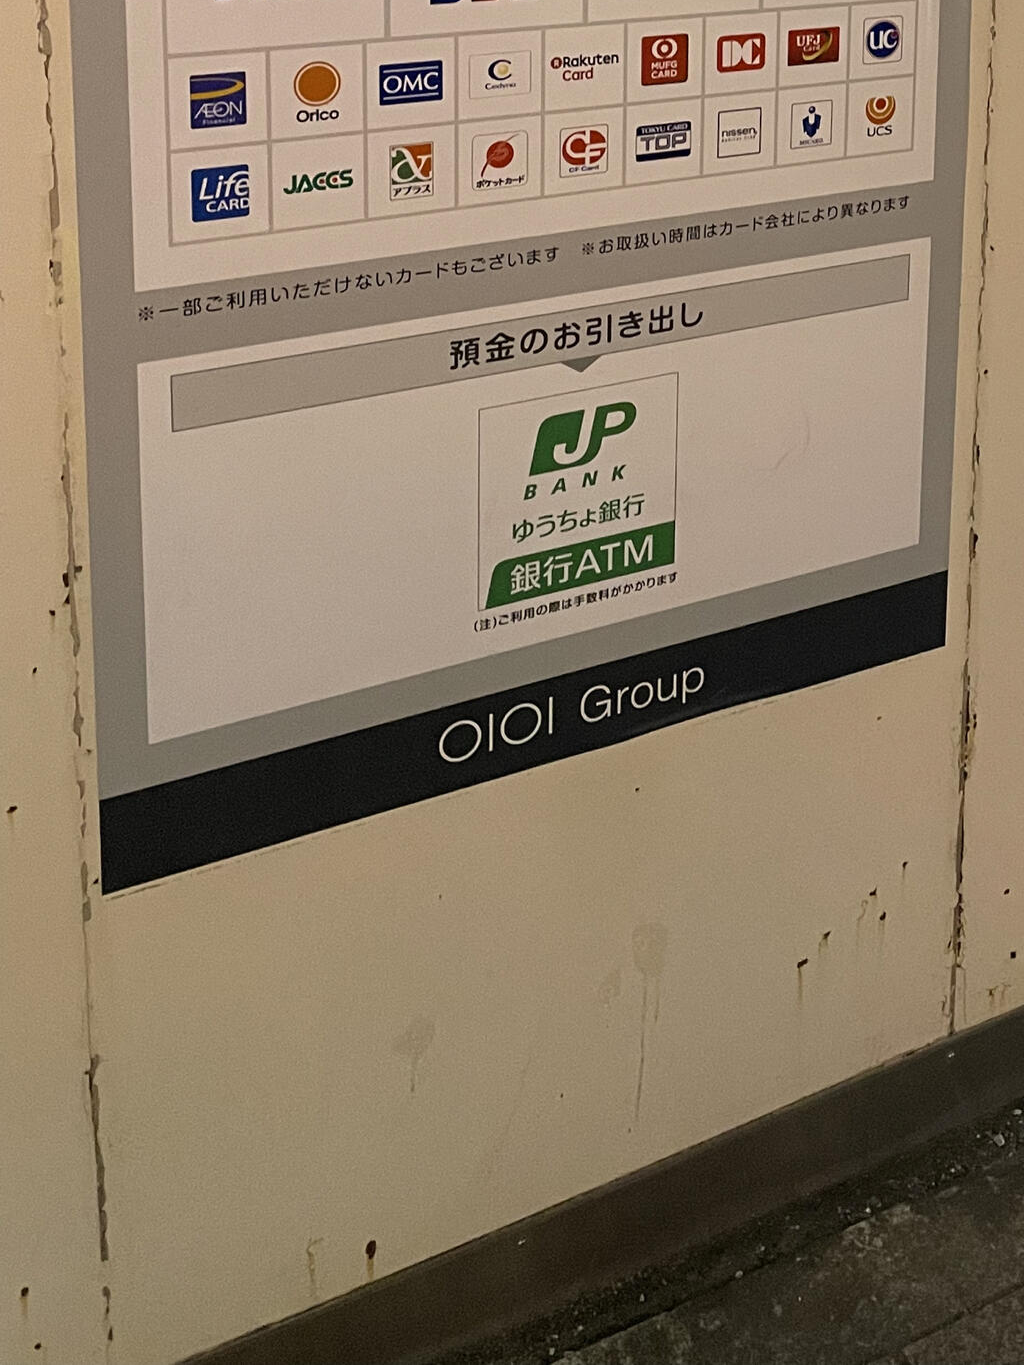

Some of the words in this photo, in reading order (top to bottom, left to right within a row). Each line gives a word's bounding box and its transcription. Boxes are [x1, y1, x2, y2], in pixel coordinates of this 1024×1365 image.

[796, 34, 821, 47] UFJ
[869, 29, 898, 51] UC
[562, 53, 620, 68] Rakuten
[722, 38, 761, 68] DC
[562, 68, 594, 82] Card
[651, 59, 678, 70] MUFG
[651, 70, 678, 80] CARD
[383, 72, 439, 94] OMC
[296, 109, 340, 123] Orico
[641, 124, 665, 134] TOKYU
[666, 122, 688, 132] CARD
[867, 125, 893, 138] UCS
[640, 132, 687, 152] TOP
[199, 170, 249, 201] Life
[283, 169, 353, 194] JACCS
[392, 184, 431, 197] アプラス
[475, 175, 525, 189] ポケットカード
[206, 197, 249, 213] CARD
[138, 245, 560, 323] ※一部ご利用いただけないカードもございます
[582, 195, 910, 256] ※お取扱い時間はカード会社により異なります
[449, 301, 703, 371] 預金のお引き出し
[528, 401, 637, 477] JP
[523, 464, 627, 501] BANK
[512, 492, 645, 544] ゆうちょ銀行
[510, 535, 654, 595] 銀行ATM
[580, 666, 705, 723] Group
